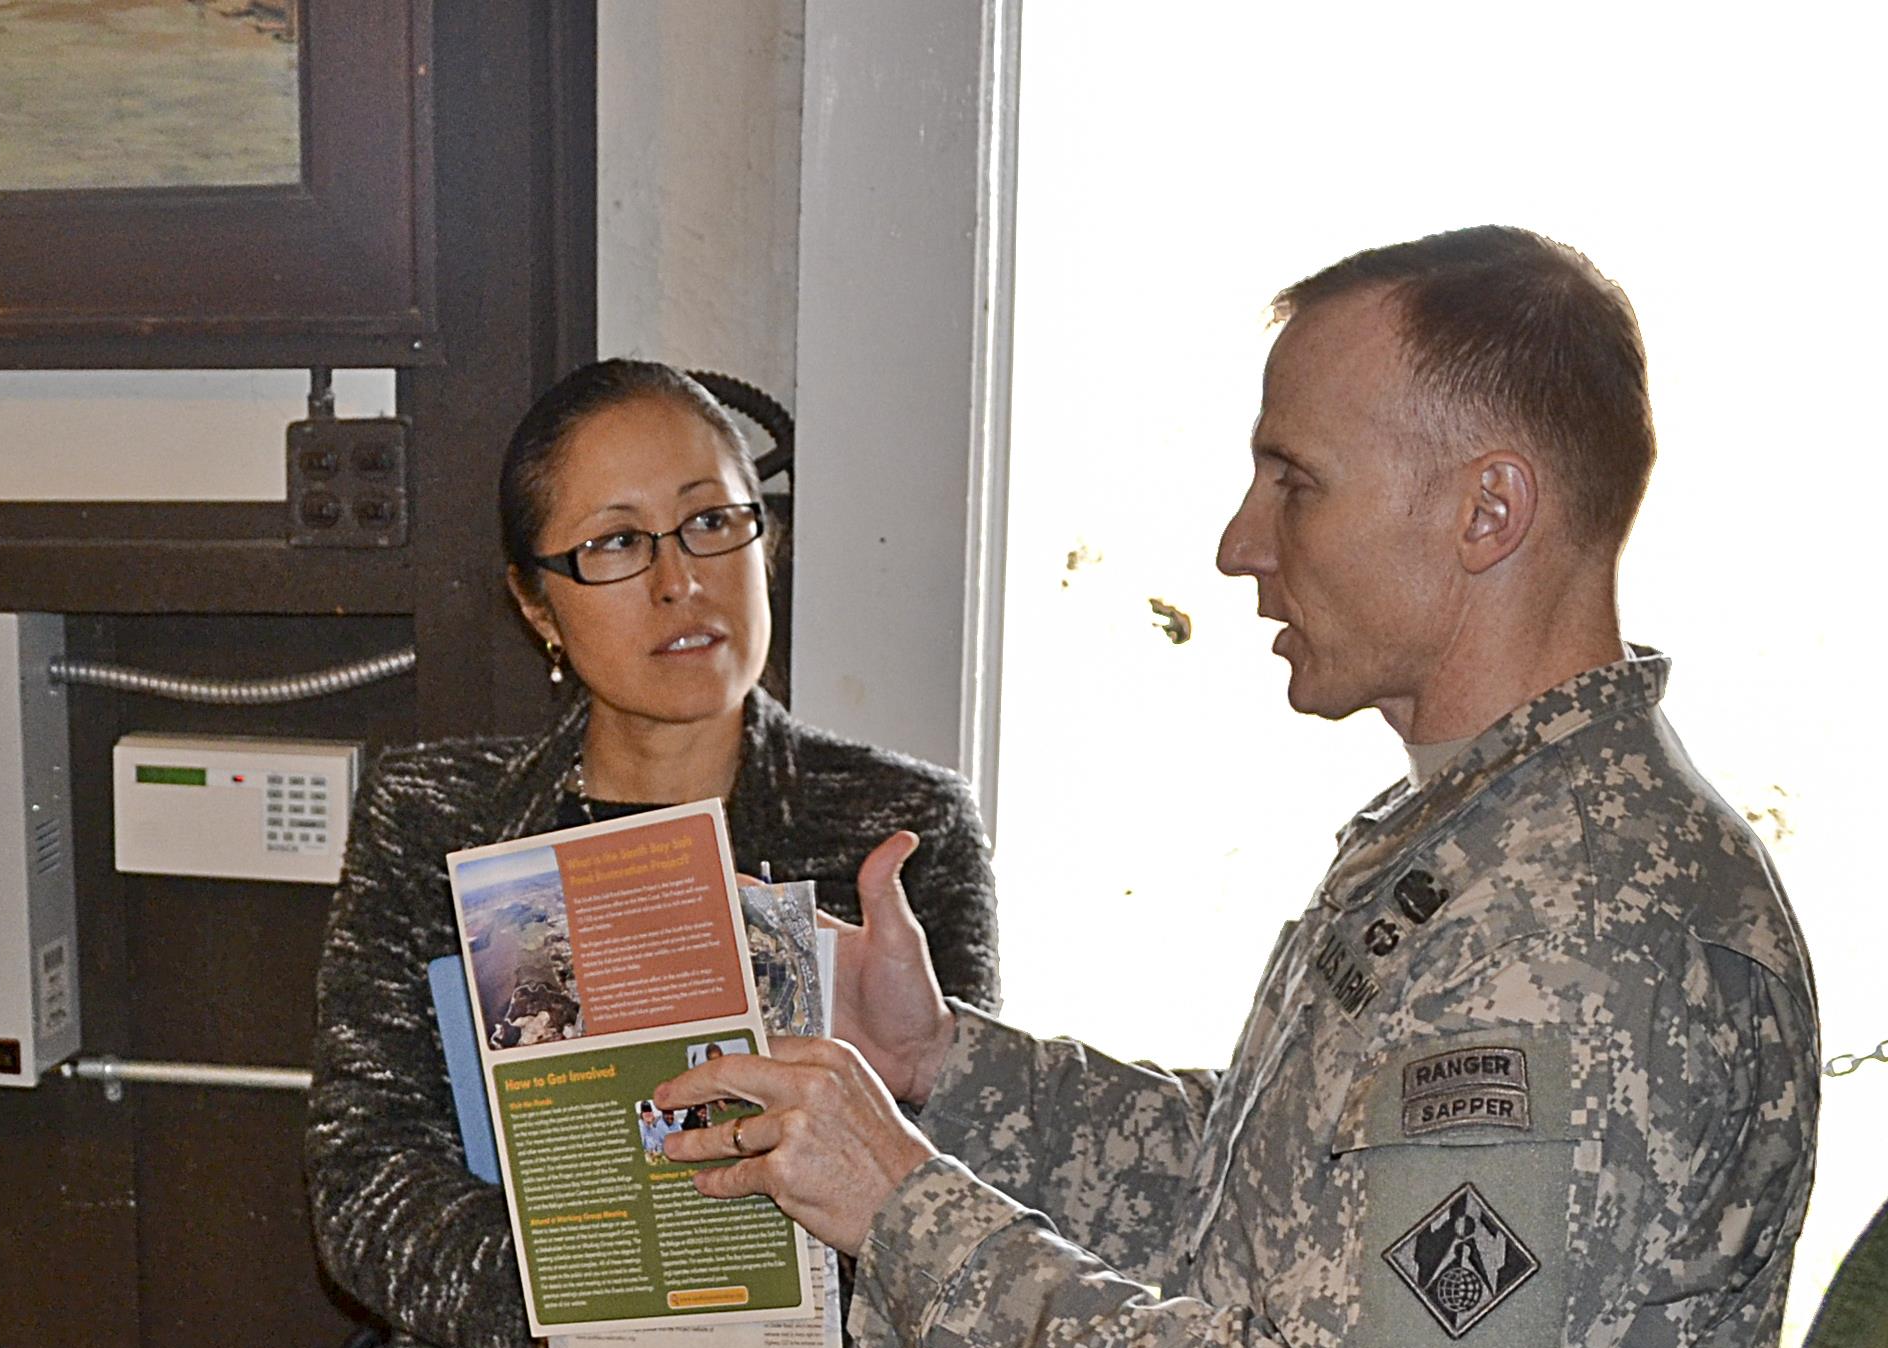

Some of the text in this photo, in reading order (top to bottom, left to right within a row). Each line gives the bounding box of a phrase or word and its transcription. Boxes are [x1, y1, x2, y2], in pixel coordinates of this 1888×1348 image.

[1332, 963, 1380, 1019] ARMY
[505, 1064, 616, 1091] How to Get Involved
[1415, 1054, 1511, 1087] RANGER
[1421, 1097, 1514, 1123] SAPPER
